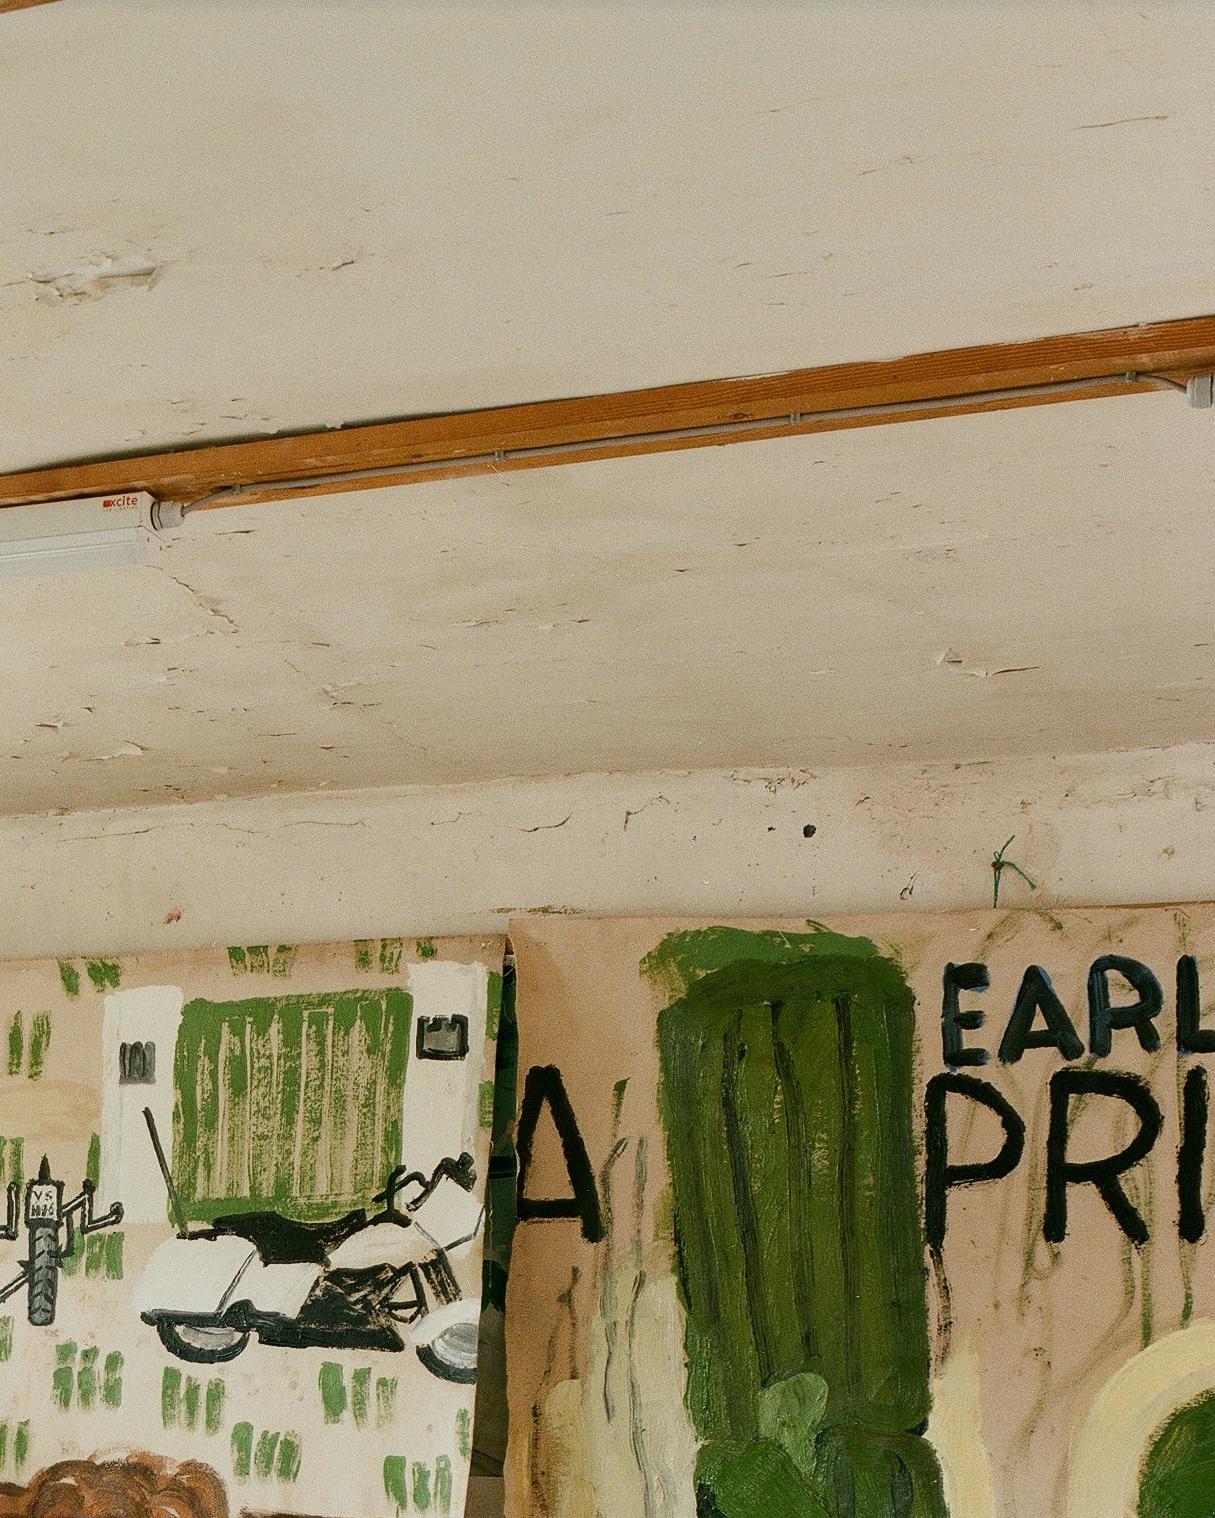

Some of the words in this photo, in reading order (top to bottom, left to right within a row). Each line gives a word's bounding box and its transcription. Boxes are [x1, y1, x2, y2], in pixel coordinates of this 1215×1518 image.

[103, 496, 138, 507] excite
[941, 954, 1215, 1068] EARL
[516, 1063, 603, 1244] A
[923, 1066, 1211, 1251] PRI
